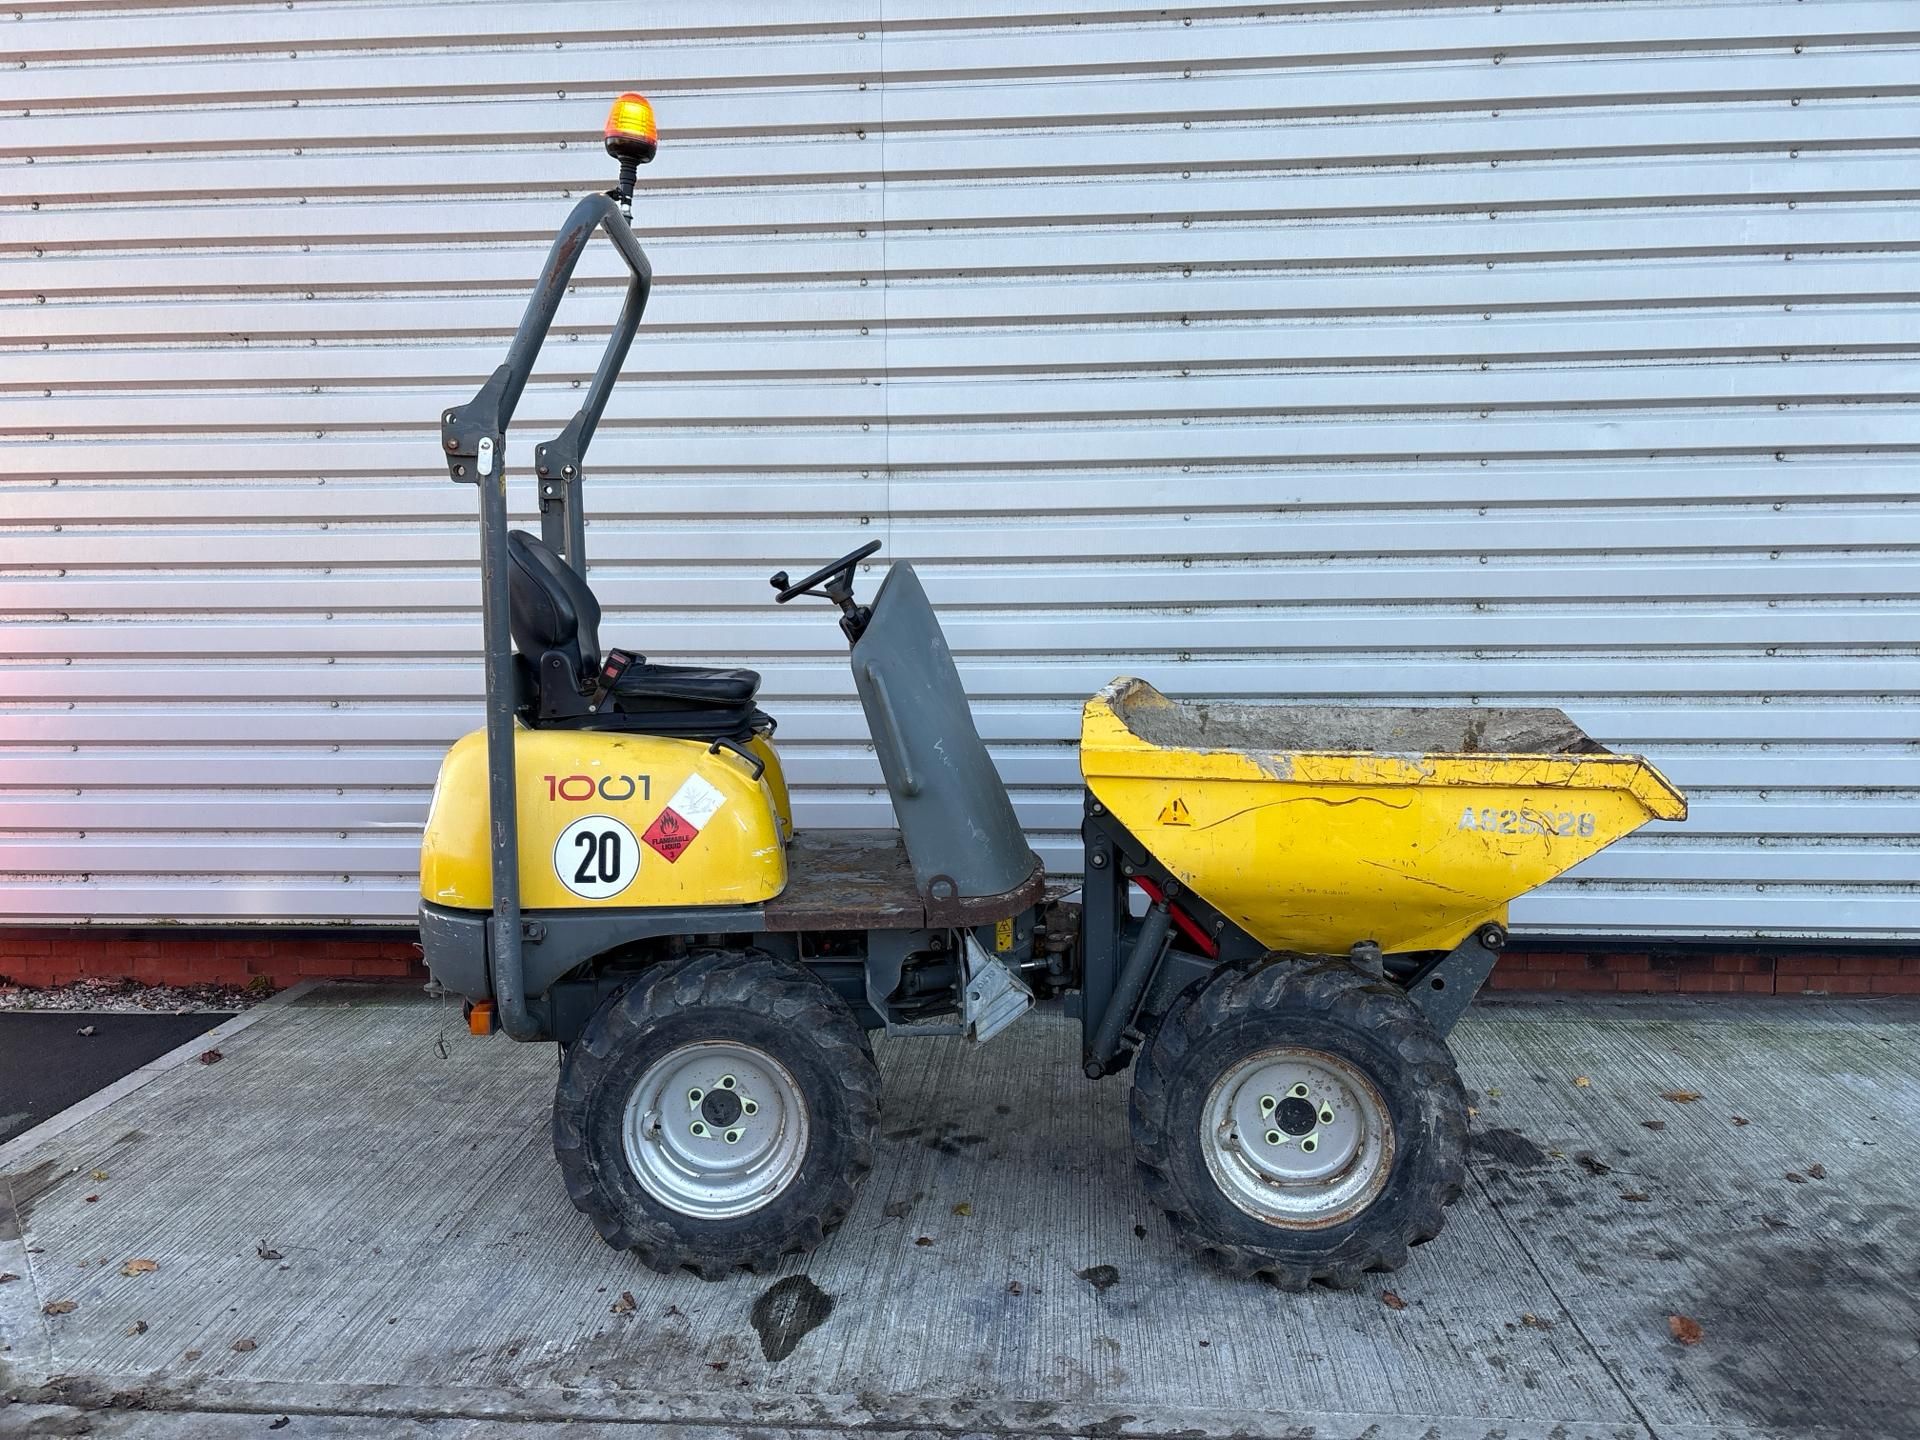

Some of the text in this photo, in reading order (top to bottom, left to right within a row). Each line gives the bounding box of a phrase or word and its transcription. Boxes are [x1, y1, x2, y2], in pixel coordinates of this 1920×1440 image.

[544, 775, 650, 801] 1001
[652, 835, 690, 846] FLAMMABLE
[662, 842, 681, 850] LIQUID
[574, 831, 620, 883] 20
